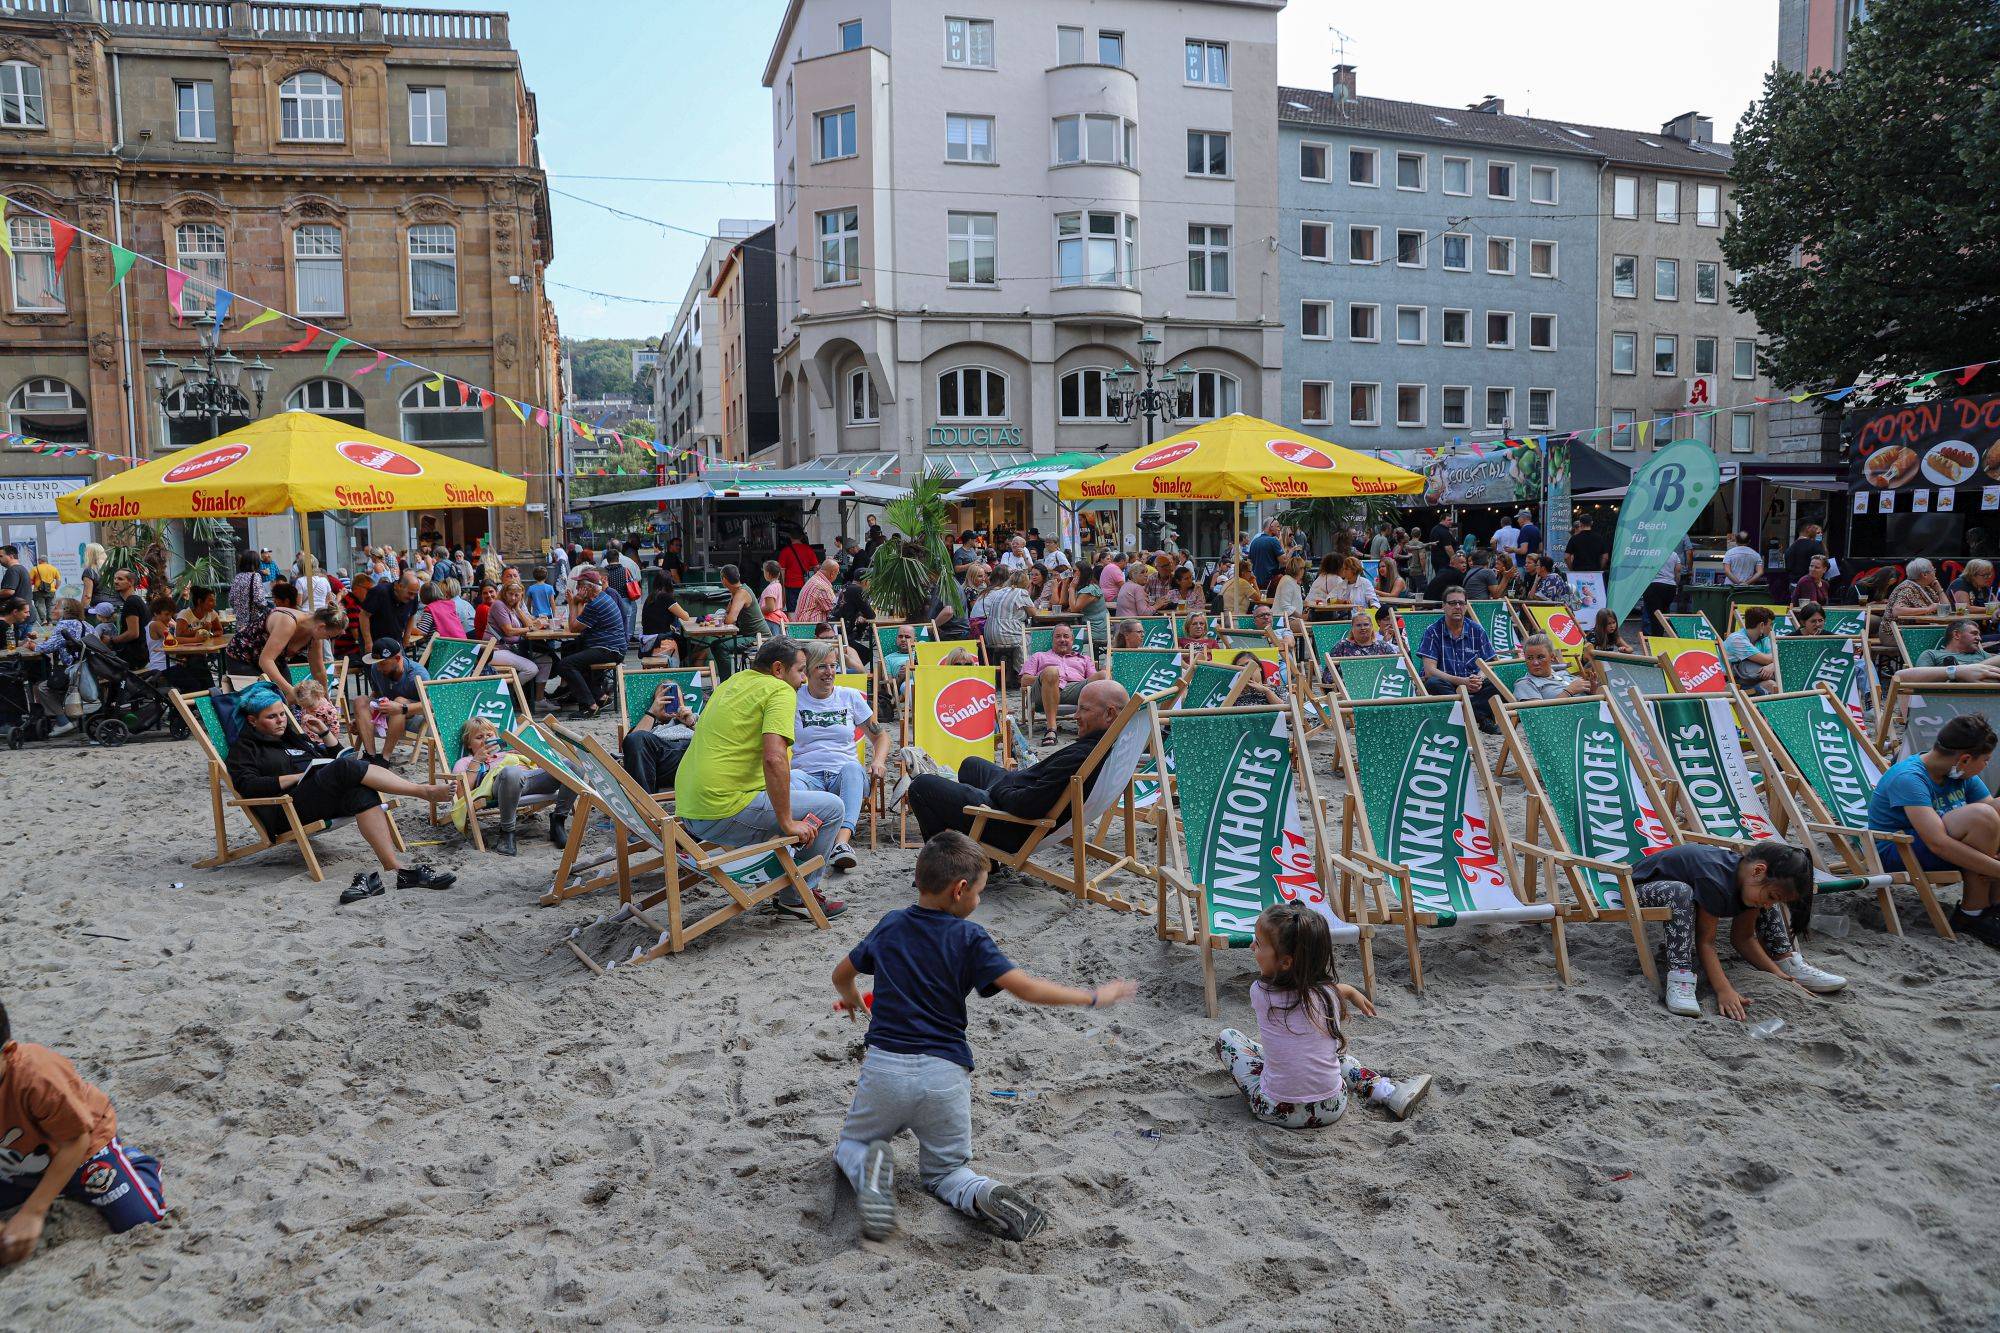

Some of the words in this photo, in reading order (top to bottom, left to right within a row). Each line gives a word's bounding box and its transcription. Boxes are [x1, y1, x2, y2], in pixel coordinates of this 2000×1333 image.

[950, 21, 961, 59] MPU
[1188, 45, 1198, 79] MPU
[929, 426, 1022, 446] DOUGLAS
[1858, 403, 1942, 456] CORN
[170, 451, 242, 476] Sinalco
[1139, 447, 1193, 466] Sinalco
[1450, 461, 1507, 484] COCKTAIL
[0, 483, 28, 491] ILFE
[34, 483, 59, 491] UND
[335, 484, 394, 506] Sinalco
[444, 482, 494, 503] Sinalco
[1081, 479, 1116, 497] Sinalco
[1152, 476, 1192, 494] Sinalco
[1260, 476, 1309, 493] Sinalco
[1351, 476, 1398, 493] Sinalco
[1465, 485, 1487, 499] BAR
[90, 495, 140, 519] Sinalco
[192, 489, 246, 512] Sinalco
[1637, 521, 1667, 530] Beach
[1632, 533, 1646, 543] für
[1624, 546, 1661, 556] Barmen
[1555, 619, 1575, 640] Sinalco
[1679, 661, 1723, 691] Sinalco
[940, 693, 996, 728] Sinalco
[1720, 734, 1748, 799] PILSENER
